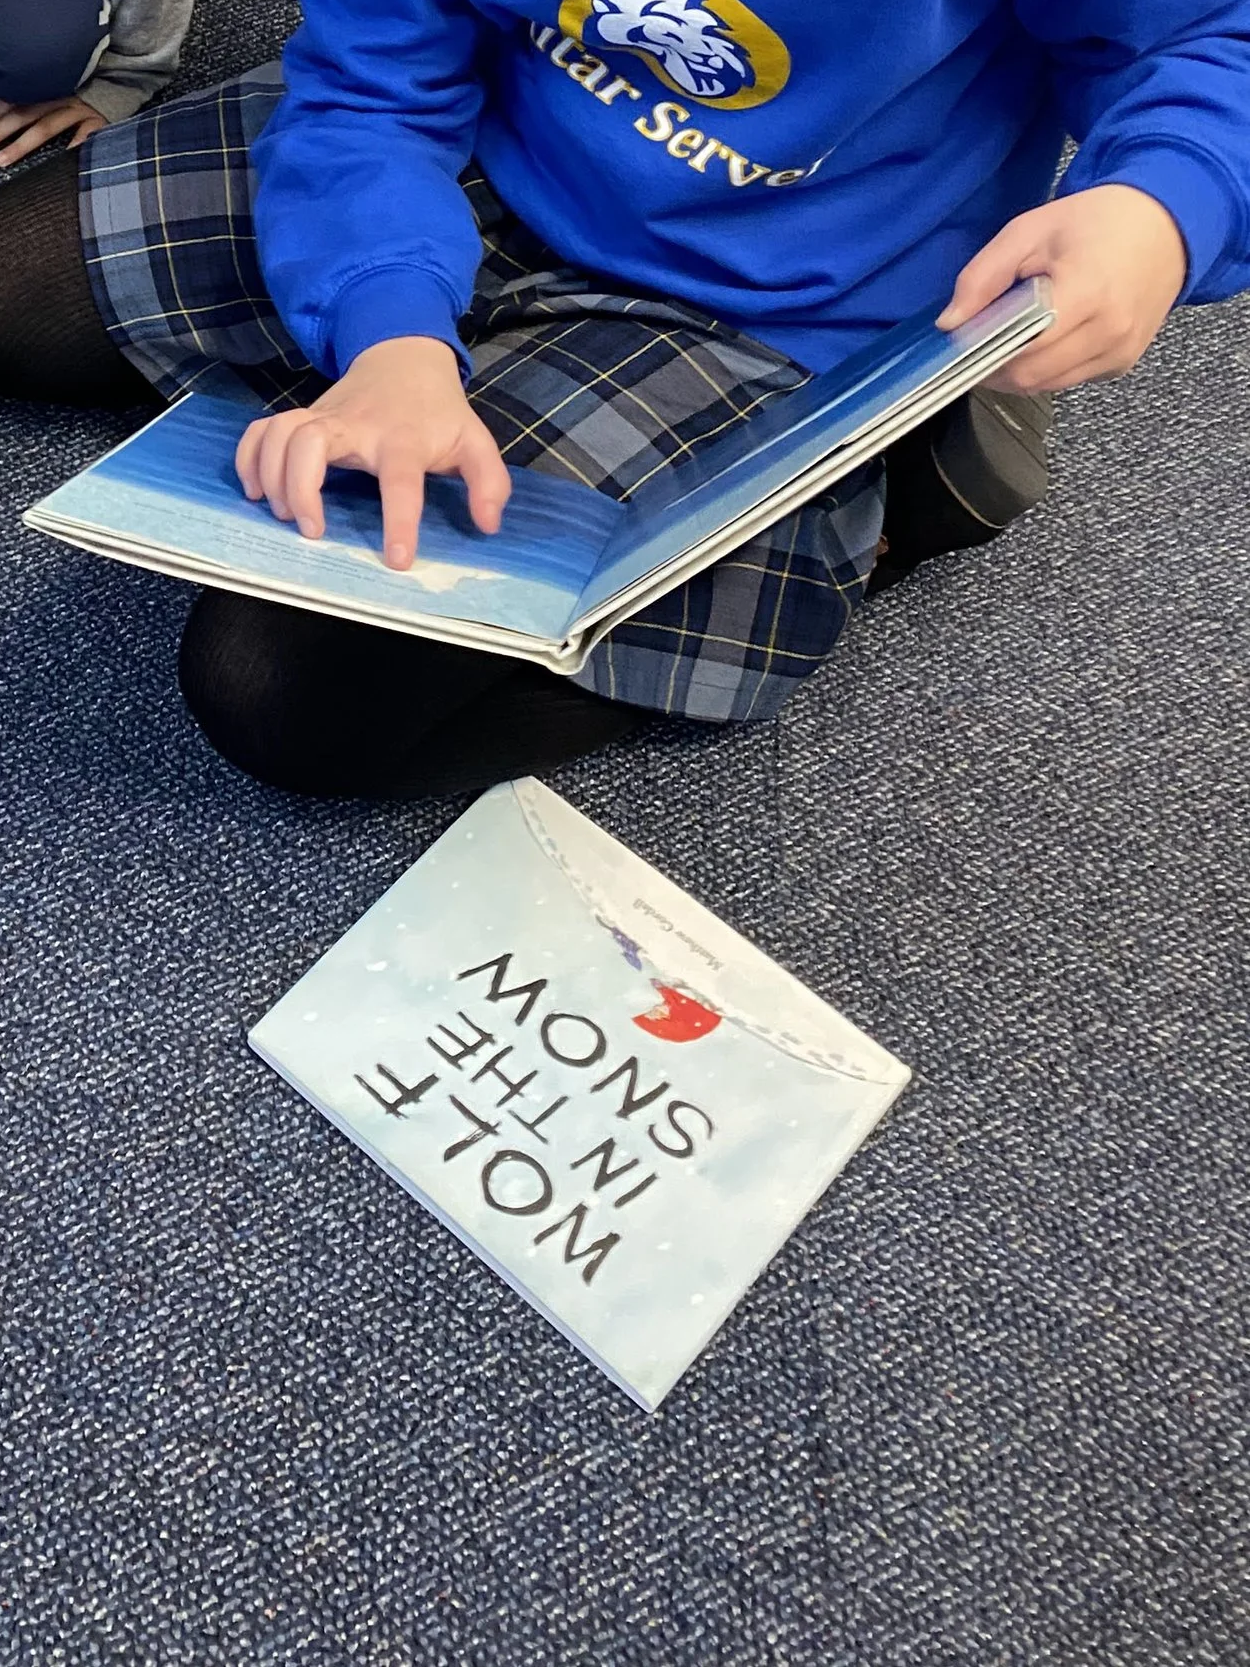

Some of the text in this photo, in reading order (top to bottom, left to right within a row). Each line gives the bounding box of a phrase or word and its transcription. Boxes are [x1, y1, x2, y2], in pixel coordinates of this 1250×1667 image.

[529, 21, 836, 187] tar Serve
[673, 927, 726, 973] Matthew
[425, 1010, 662, 1210] IN THE
[456, 951, 716, 1160] SNOW
[353, 1062, 623, 1286] WOLF
